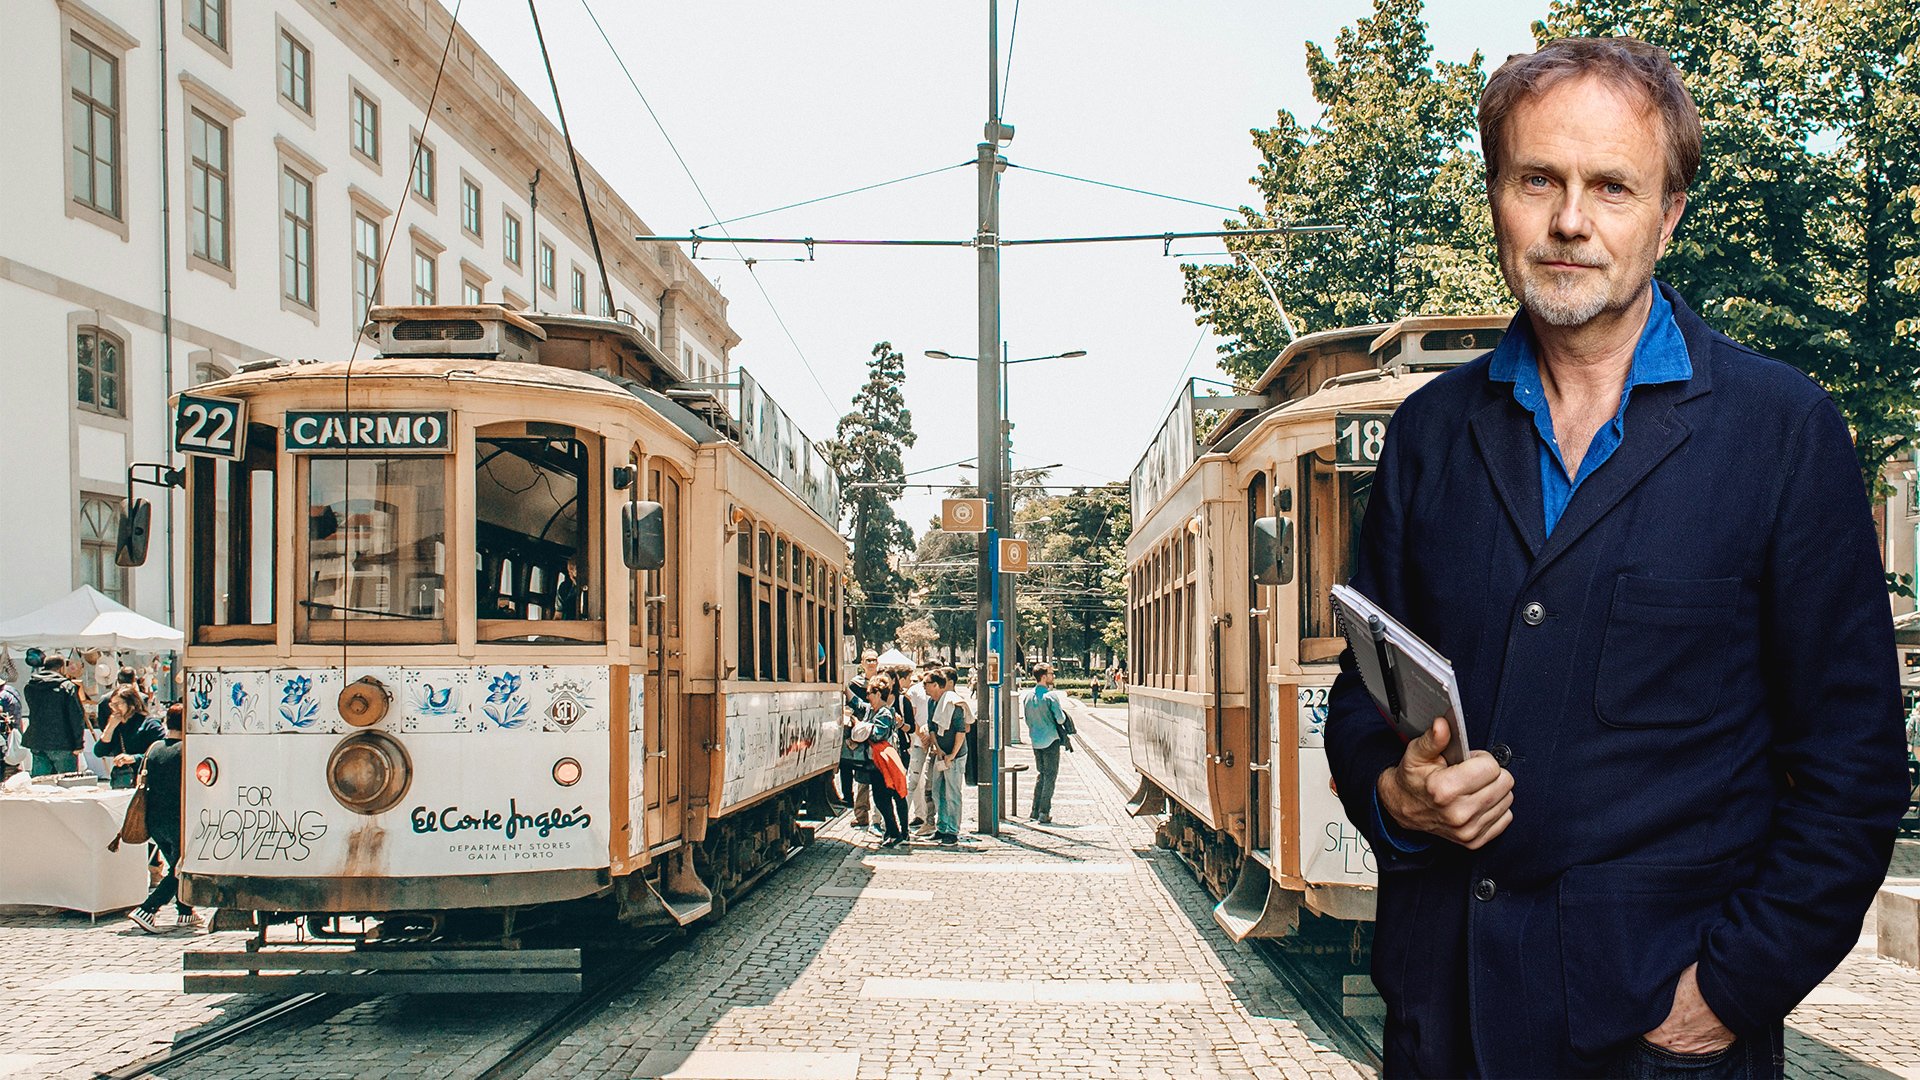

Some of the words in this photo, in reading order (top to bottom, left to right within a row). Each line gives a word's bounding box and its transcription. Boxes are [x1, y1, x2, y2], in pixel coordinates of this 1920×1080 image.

[180, 404, 233, 450] 22
[292, 416, 441, 445] CARMO
[1342, 420, 1386, 461] 18
[188, 673, 213, 693] 218
[238, 786, 272, 806] FOR
[195, 808, 327, 841] SHOPPING
[411, 806, 438, 834] El
[440, 806, 503, 832] Corte
[505, 798, 592, 840] Inglés
[197, 831, 316, 861] LOVERS
[450, 843, 523, 852] DEPARTMENT
[529, 841, 572, 850] STORES
[468, 853, 497, 861] GAIA
[514, 851, 554, 860] PORTO
